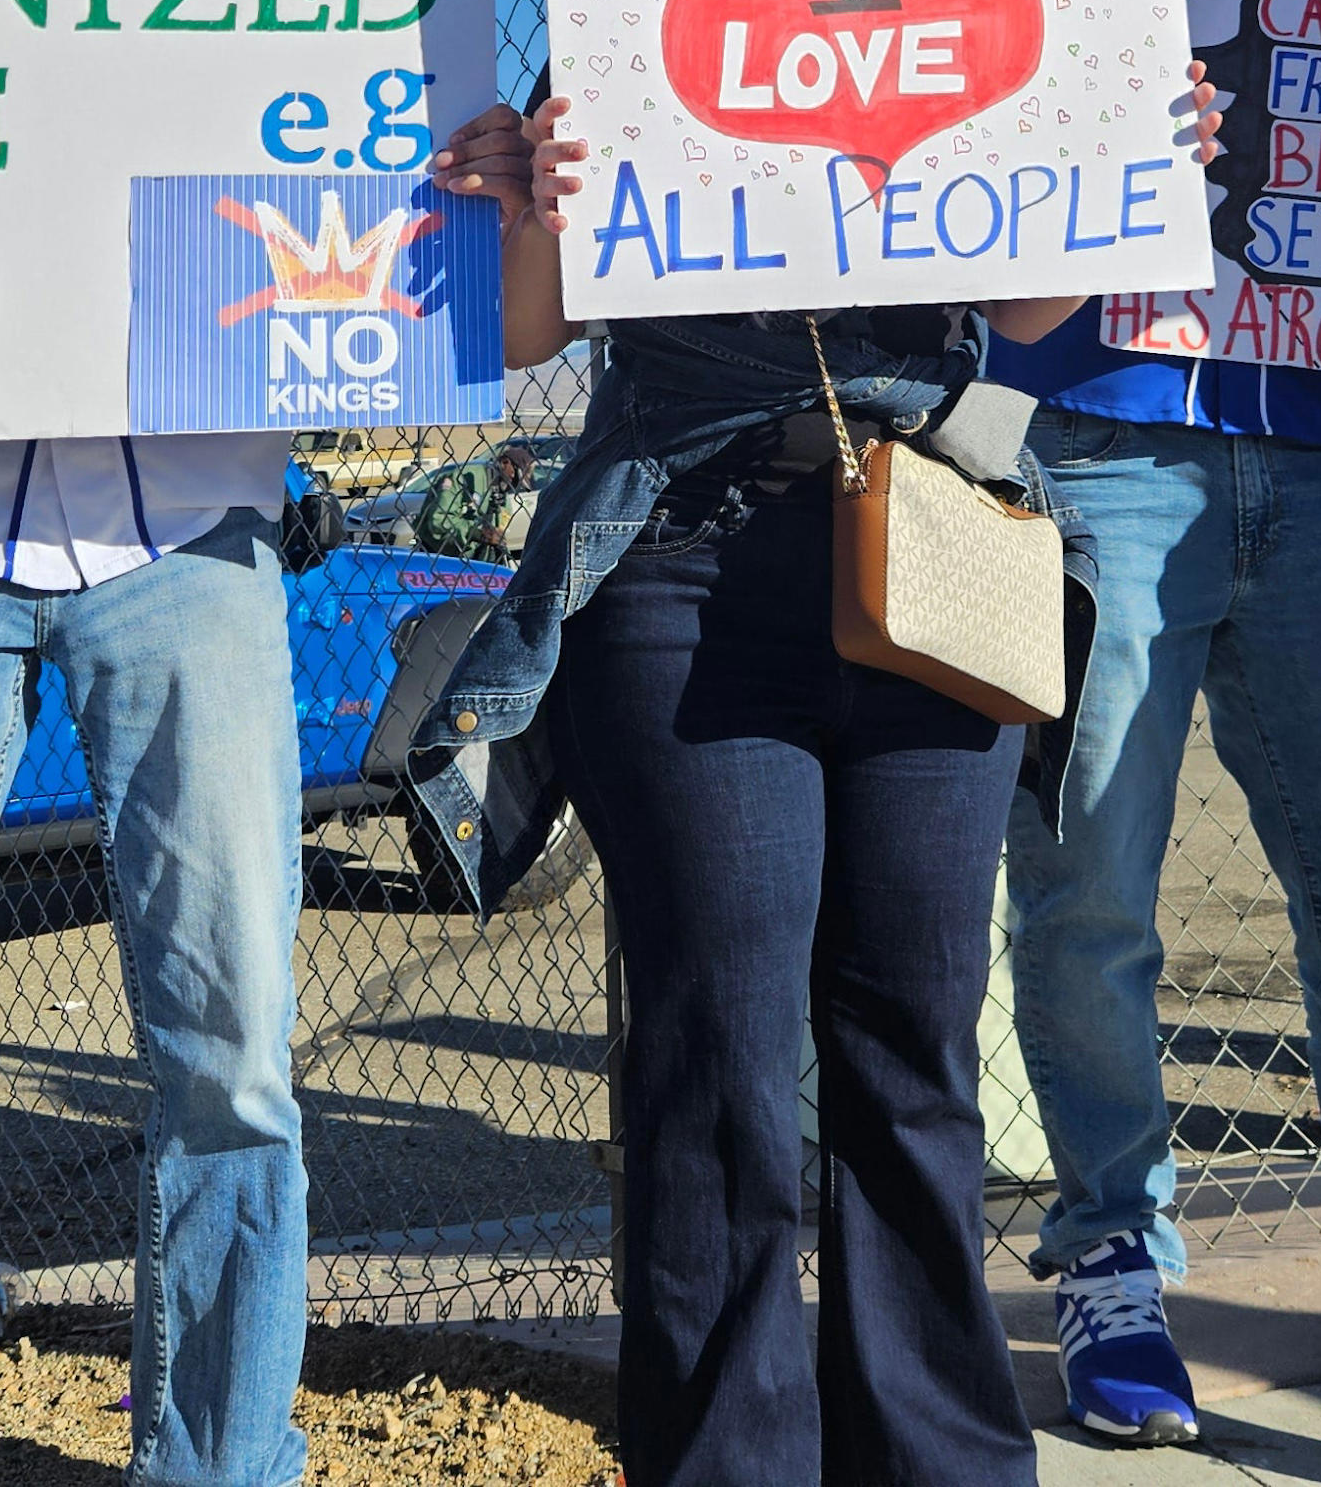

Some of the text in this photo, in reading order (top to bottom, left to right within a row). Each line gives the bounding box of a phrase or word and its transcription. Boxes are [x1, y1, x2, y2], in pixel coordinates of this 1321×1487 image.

[718, 20, 966, 110] LOVE
[593, 154, 1173, 279] ALL PEOPLE
[269, 317, 400, 382] NO
[268, 382, 401, 415] KINGS
[397, 571, 512, 589] RUBICON
